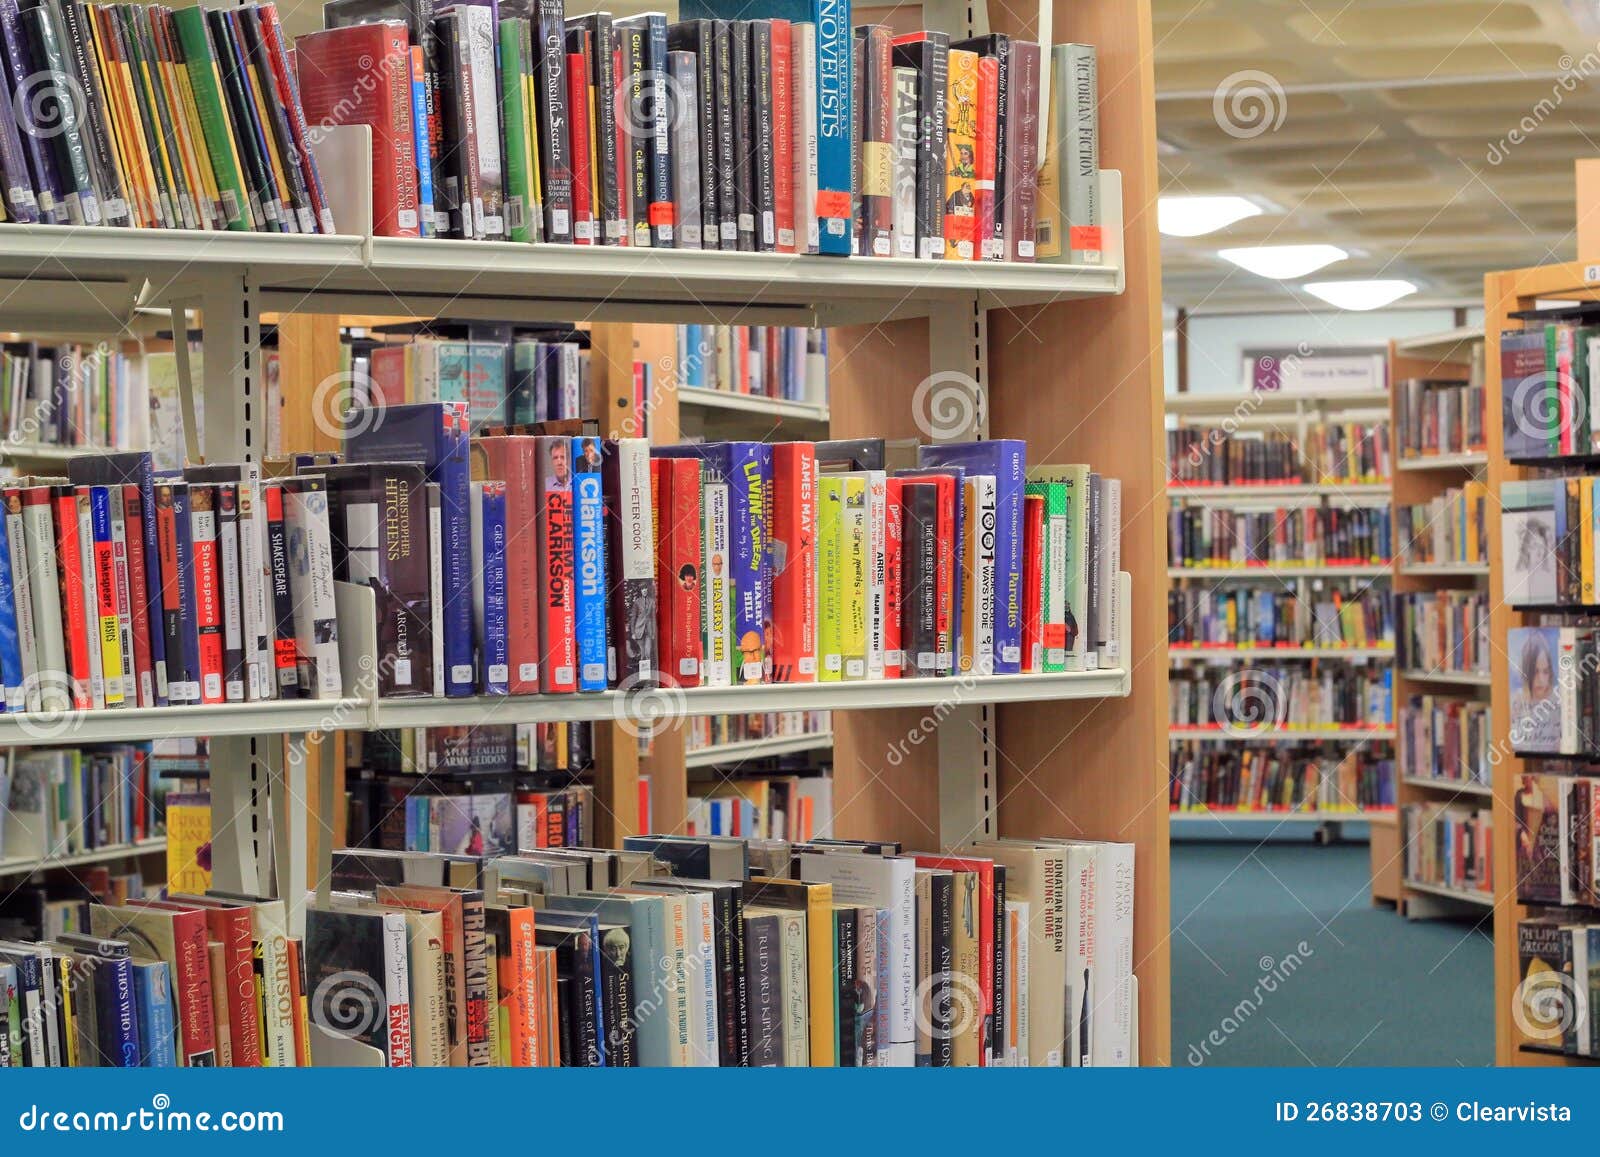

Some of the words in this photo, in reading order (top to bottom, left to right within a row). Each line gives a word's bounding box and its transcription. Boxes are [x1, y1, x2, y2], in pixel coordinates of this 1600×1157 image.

[66, 5, 77, 43] POLITICAL
[74, 44, 92, 97] SHAKESPEARE
[547, 35, 561, 58] The
[632, 34, 641, 57] CULT
[462, 71, 471, 100] SALMAN
[547, 62, 562, 111] Dracula
[633, 61, 642, 98] FICTION
[778, 60, 786, 98] FICTION
[821, 0, 839, 137] NOVELISTS
[839, 5, 847, 131] CONTEMPORARY
[999, 64, 1007, 90] Realist
[417, 94, 425, 110] His
[655, 79, 665, 116] SCIENCE
[1076, 56, 1092, 122] VICTORIAN
[418, 115, 428, 138] Dark
[465, 102, 473, 134] RUSHDIE
[606, 95, 614, 132] VIRGINIA
[779, 114, 787, 154] ENGLISH
[395, 139, 401, 153] OF
[403, 140, 411, 162] THE
[552, 117, 563, 160] Secrets
[656, 117, 668, 154] FICTION
[809, 135, 817, 158] Chick
[896, 73, 916, 202] FAULKS
[1080, 128, 1093, 177] FICTION
[421, 143, 430, 185] Materials
[879, 146, 888, 193] FAULKS
[743, 461, 762, 519] LIVIN'
[801, 454, 810, 500] JAMES
[385, 478, 399, 561] HITCHENS
[399, 480, 410, 557] CHRISTOPHER
[632, 488, 641, 520] PETER
[801, 504, 810, 533] MAY
[319, 544, 330, 559] The
[451, 516, 460, 548] SIMON
[494, 525, 504, 562] GREAT
[548, 494, 563, 607] CLARKSON
[563, 498, 573, 580] JEREMY
[581, 478, 599, 596] Clarkson
[632, 523, 642, 551] COOK
[750, 527, 761, 571] DREEM
[925, 525, 933, 537] THE
[925, 539, 933, 554] VERY
[981, 504, 994, 563] 1001
[101, 550, 112, 607] Shakespeare
[202, 545, 214, 623] Shakespeare
[272, 534, 287, 595] SHAKESPEARE
[925, 557, 933, 574] BEST
[981, 566, 989, 592] WAYS
[132, 540, 144, 633] SHAKESPEARE
[495, 567, 504, 610] BRITISH
[713, 578, 723, 632] HARRY
[744, 592, 753, 621] HILL
[754, 581, 762, 628] HARRY
[925, 586, 933, 606] LINDA
[981, 597, 989, 609] TO
[1007, 572, 1019, 628] Parodies
[105, 621, 117, 642] BASICS
[564, 616, 573, 634] the
[585, 603, 594, 624] Can
[925, 609, 933, 630] SMITH
[981, 613, 989, 629] DIE
[565, 637, 573, 665] bend
[585, 638, 596, 662] Be?
[444, 753, 508, 767] ARMAGEDDON
[942, 885, 950, 906] Ways
[1045, 860, 1053, 904] DRIVING
[1054, 859, 1063, 912] JONATHAN
[1087, 858, 1095, 910] SALMAN
[1115, 863, 1123, 921] SCHAMA
[1123, 868, 1131, 916] SIMON
[675, 924, 683, 946] JAMES
[1045, 909, 1053, 939] HOME
[1054, 917, 1063, 953] RABAN
[183, 941, 195, 978] Secret
[195, 925, 206, 970] Agatha
[234, 917, 254, 999] FALCO
[464, 901, 488, 1000] FRANKIE
[521, 923, 532, 971] GEORGE
[863, 914, 874, 976] Lessing
[117, 962, 128, 999] WHO'S
[273, 936, 291, 1028] CRUSOE
[758, 936, 769, 1003] RUDYARD
[941, 946, 950, 1008] ANDREW
[121, 1002, 130, 1030] WHO
[187, 984, 200, 1040] Notebooks
[585, 989, 593, 1016] feast
[618, 973, 630, 1028] Stepping
[389, 1004, 401, 1067] ENGLA
[762, 1007, 771, 1059] KIPLING
[941, 1011, 950, 1067] MOTION
